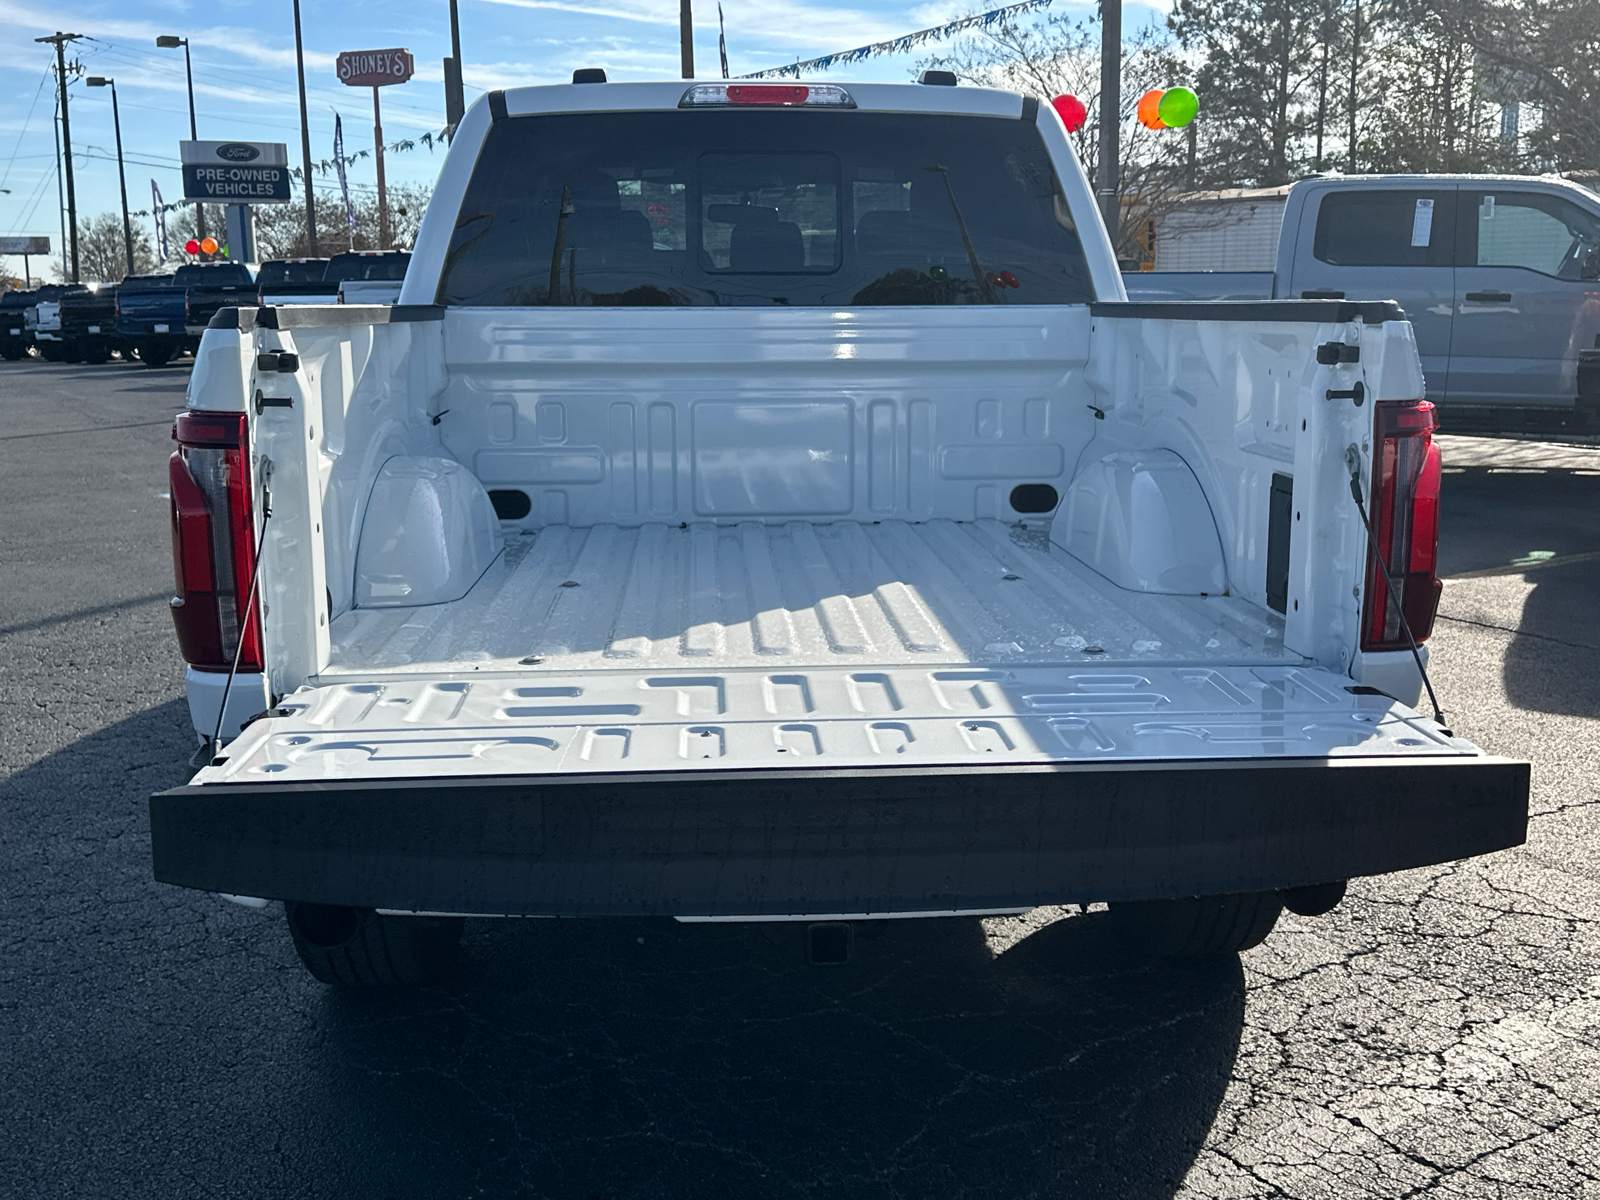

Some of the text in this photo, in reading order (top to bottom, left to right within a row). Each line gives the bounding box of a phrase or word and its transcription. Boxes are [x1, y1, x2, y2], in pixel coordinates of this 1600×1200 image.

[340, 51, 405, 79] SHONEY'S
[226, 147, 250, 158] Ford
[196, 168, 280, 182] PRE-OWNED
[205, 182, 274, 195] VEHICLES
